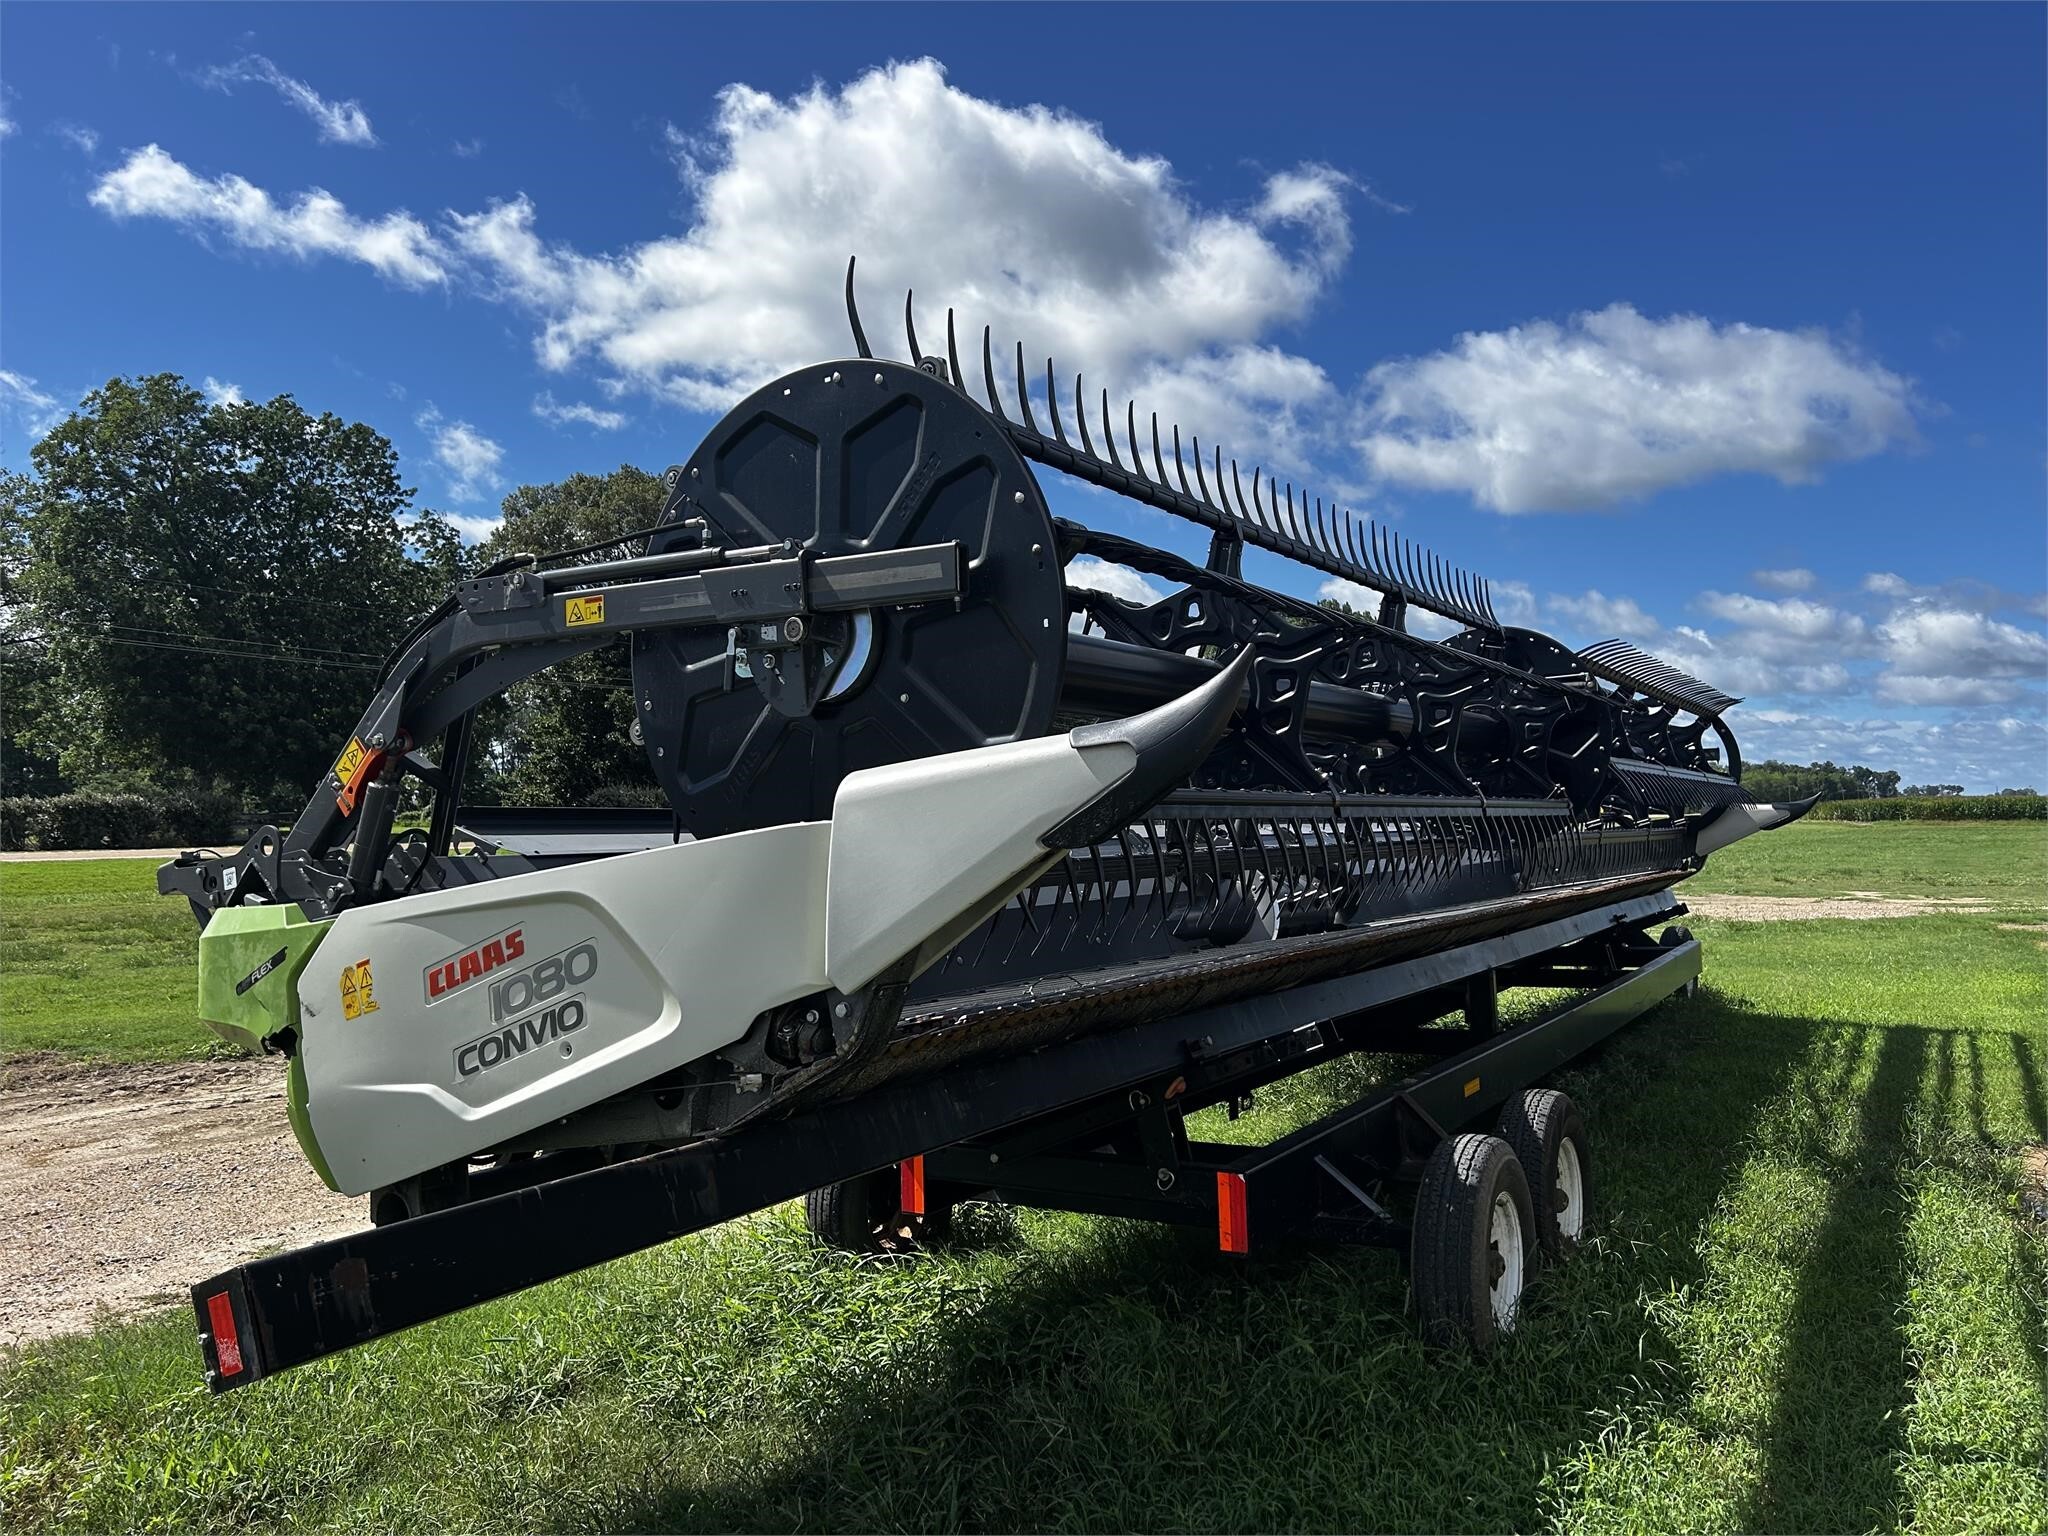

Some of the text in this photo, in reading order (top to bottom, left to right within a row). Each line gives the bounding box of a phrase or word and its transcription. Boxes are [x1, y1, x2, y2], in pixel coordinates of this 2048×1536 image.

[251, 960, 273, 983] FLEX
[429, 929, 525, 997] CLAAS
[491, 944, 598, 1022] 1080
[458, 1000, 584, 1076] CONVIO
